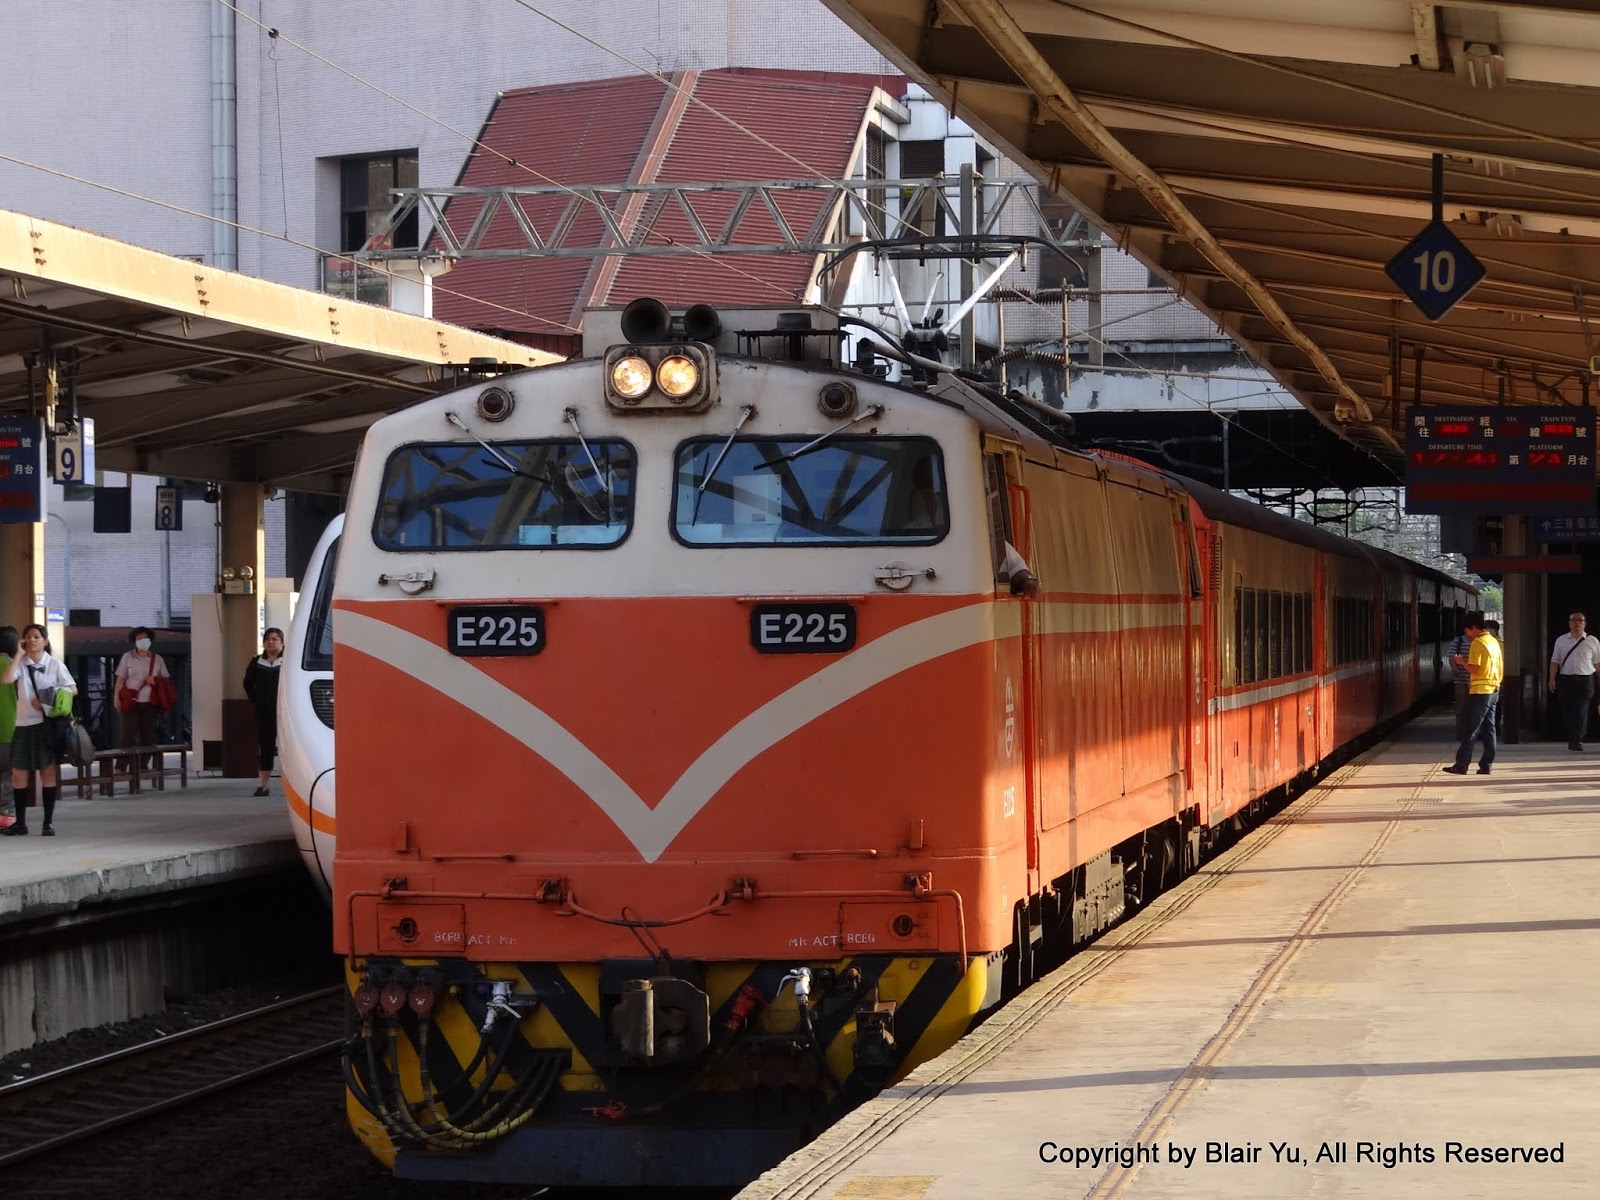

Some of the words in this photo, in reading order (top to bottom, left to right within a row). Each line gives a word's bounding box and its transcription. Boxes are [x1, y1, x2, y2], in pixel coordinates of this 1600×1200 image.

[1413, 250, 1456, 292] 10
[14, 464, 34, 475] 月台
[61, 448, 75, 480] 9
[1567, 454, 1589, 466] 月台
[161, 505, 172, 528] 8
[457, 616, 538, 647] E225
[760, 613, 847, 644] E225
[812, 935, 838, 947] ACT
